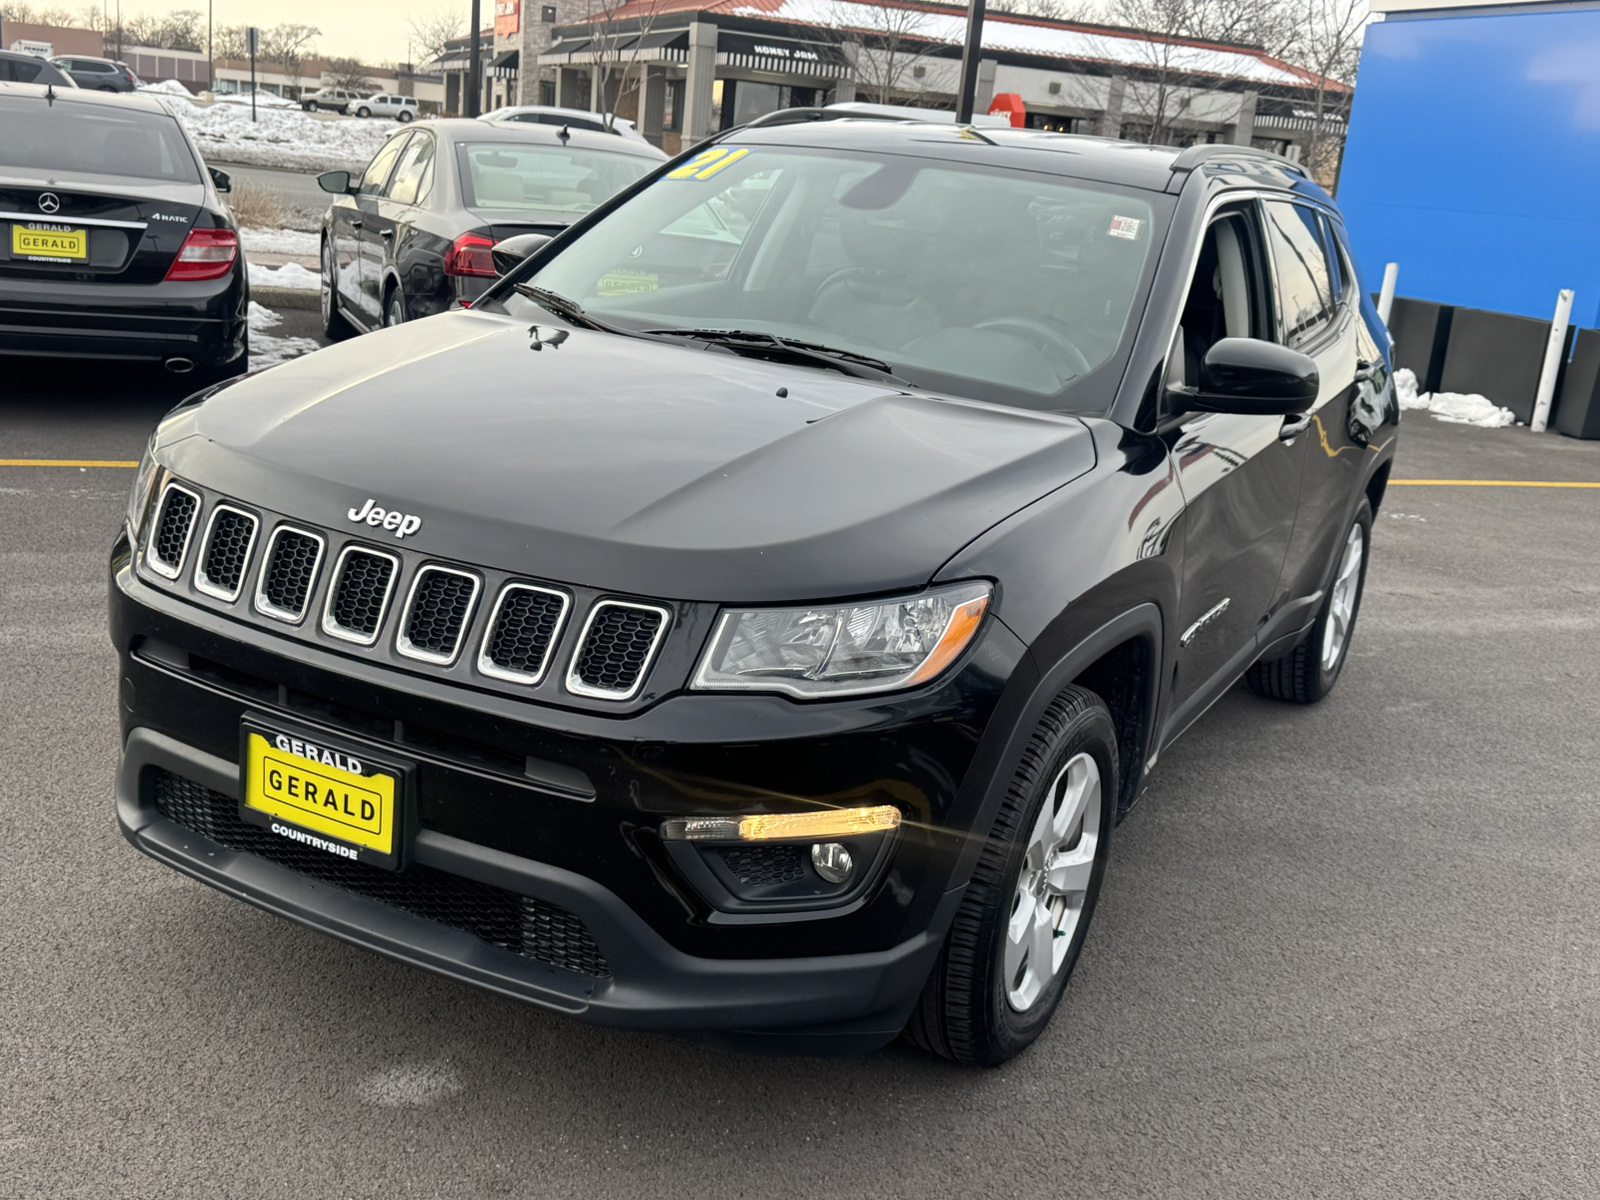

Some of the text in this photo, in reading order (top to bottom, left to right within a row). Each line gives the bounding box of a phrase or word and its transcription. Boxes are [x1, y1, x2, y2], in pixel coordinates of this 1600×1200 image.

[754, 45, 819, 60] HONEY JAM
[665, 148, 750, 181] 21
[22, 237, 77, 250] GERALD
[28, 222, 71, 232] GERALD
[347, 498, 422, 539] Jeep
[275, 733, 363, 776] GERALD
[268, 769, 376, 822] GERALD
[270, 822, 359, 861] COUNTRYSIDE
